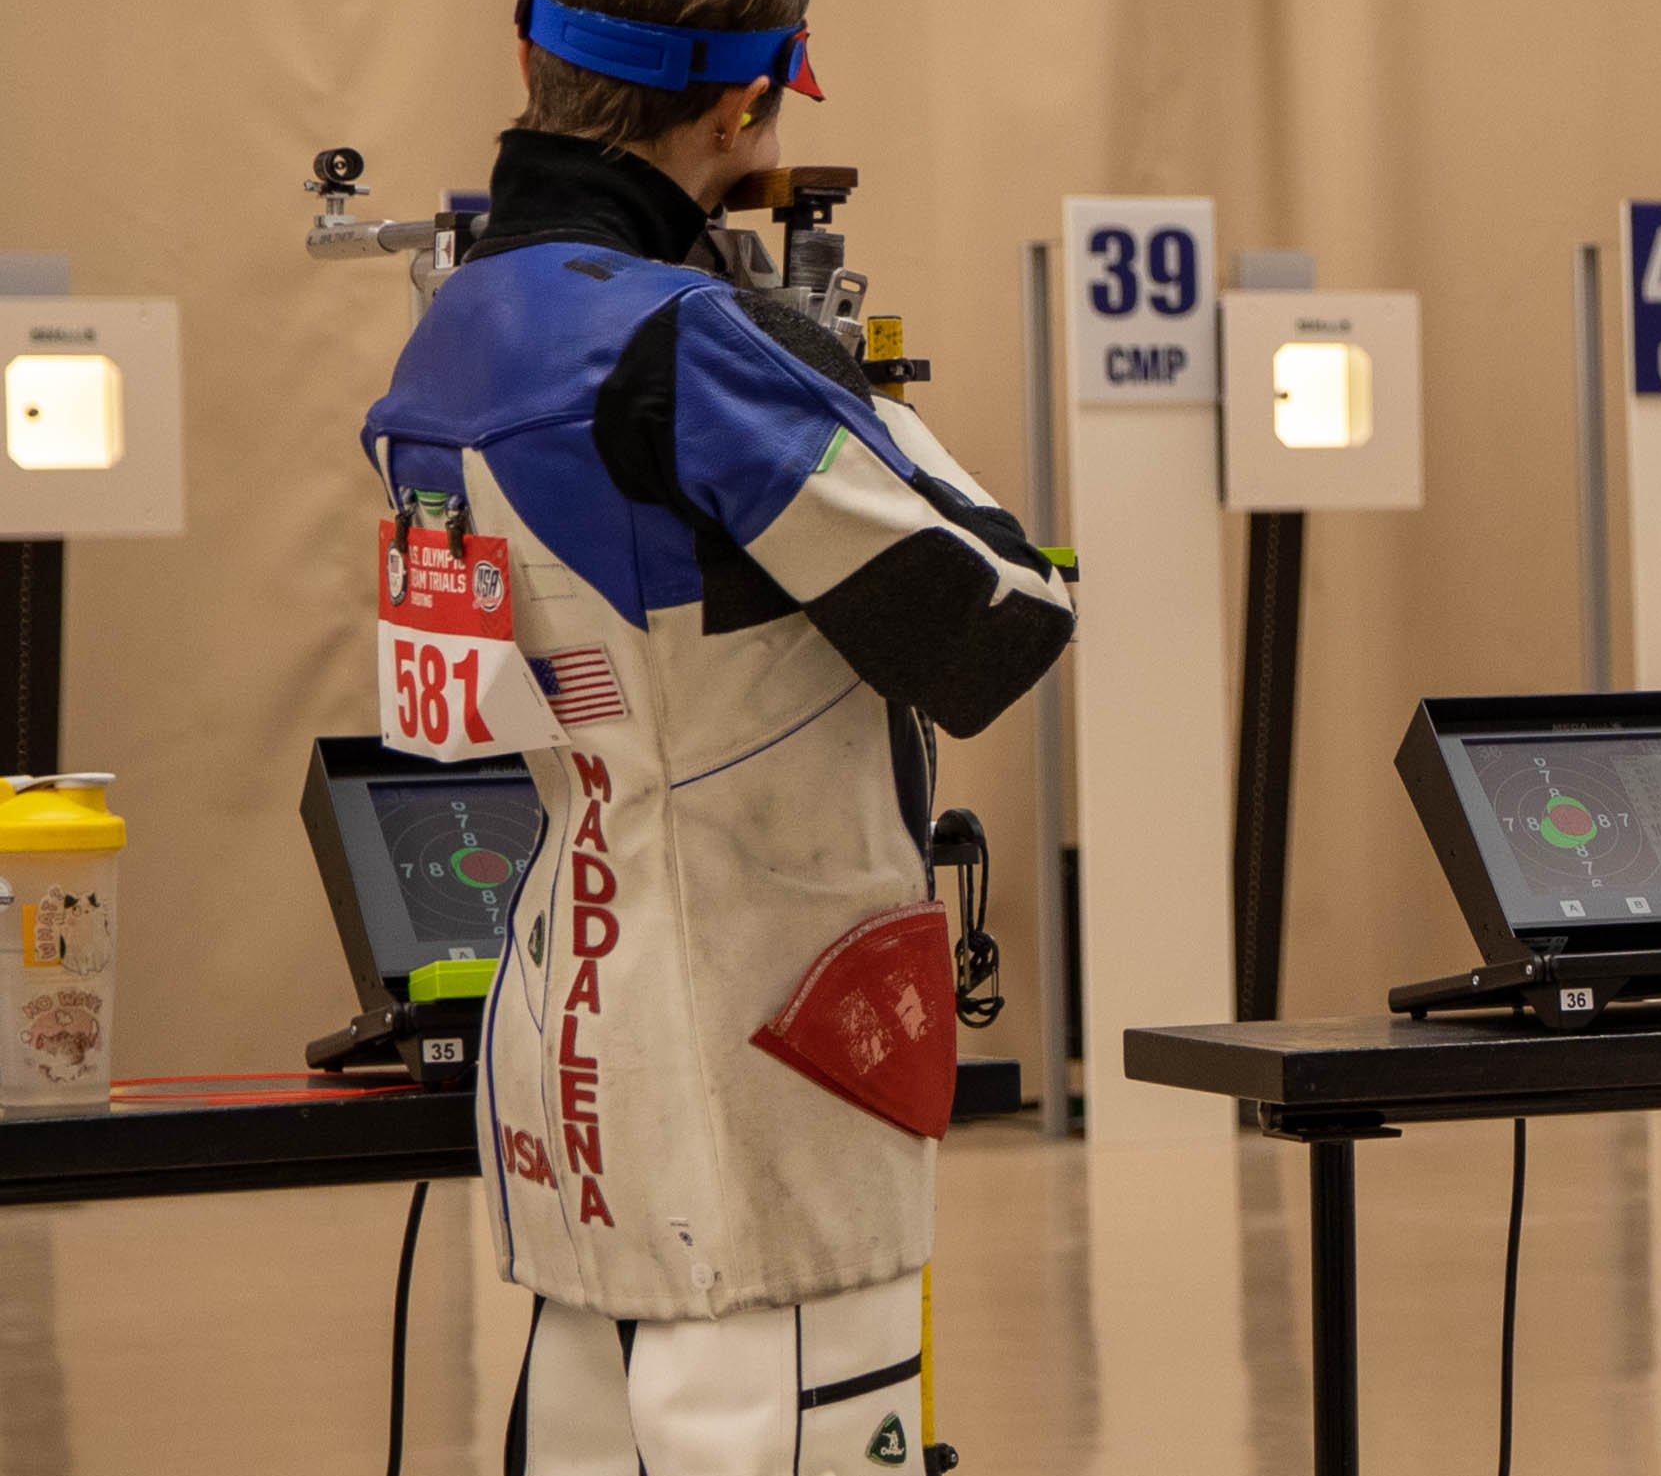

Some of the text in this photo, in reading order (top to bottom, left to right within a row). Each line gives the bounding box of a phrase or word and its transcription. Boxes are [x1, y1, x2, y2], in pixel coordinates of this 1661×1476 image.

[1088, 226, 1198, 317] 39
[1105, 345, 1187, 387] CMP
[428, 570, 468, 594] TRIALS
[394, 639, 496, 746] 581
[557, 751, 620, 1227] MADDALENA
[1567, 992, 1587, 1009] 36
[431, 1042, 456, 1062] 35
[499, 1120, 557, 1191] USA
